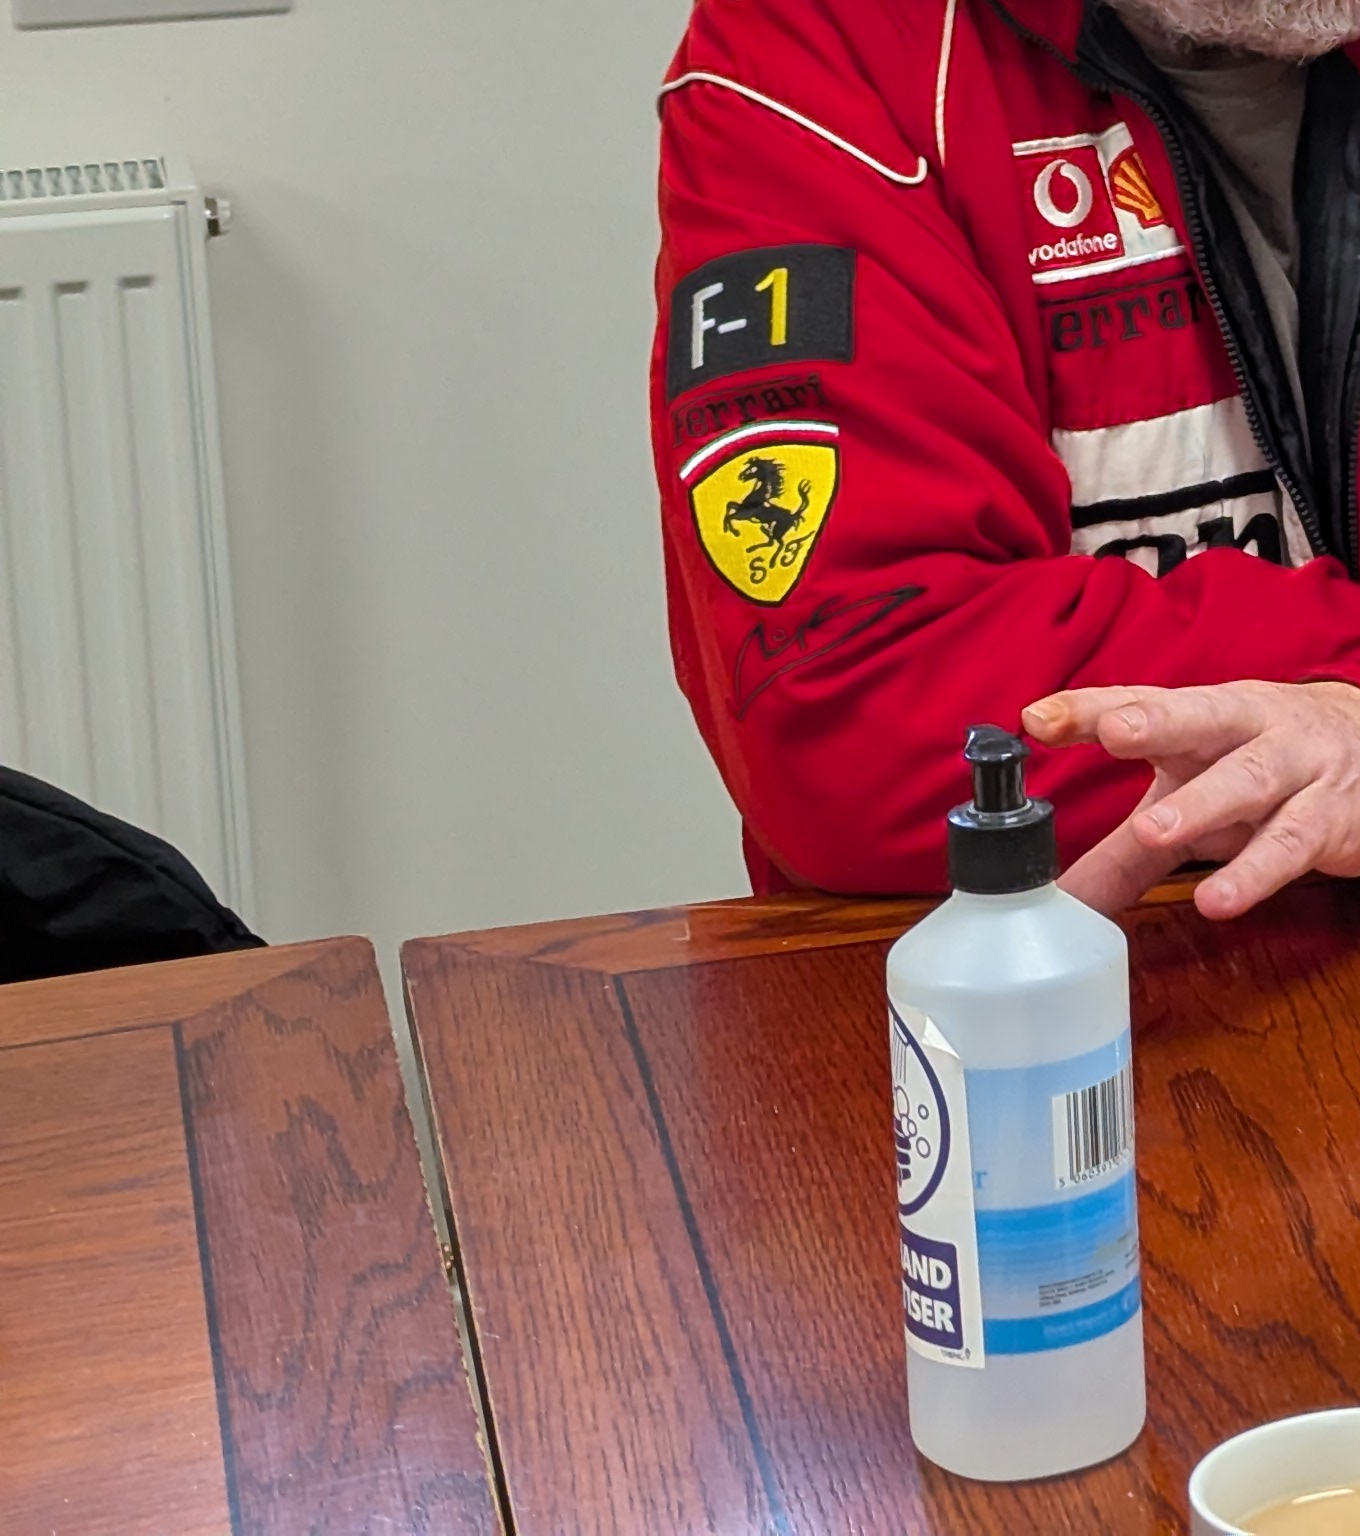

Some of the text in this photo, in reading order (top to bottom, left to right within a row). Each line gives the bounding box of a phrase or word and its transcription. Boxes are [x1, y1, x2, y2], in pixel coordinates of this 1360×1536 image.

[1027, 232, 1119, 267] vodafone
[691, 267, 790, 369] F-1
[671, 372, 832, 449] Ferrari
[901, 1243, 952, 1290] AND
[902, 1280, 956, 1334] TISER
